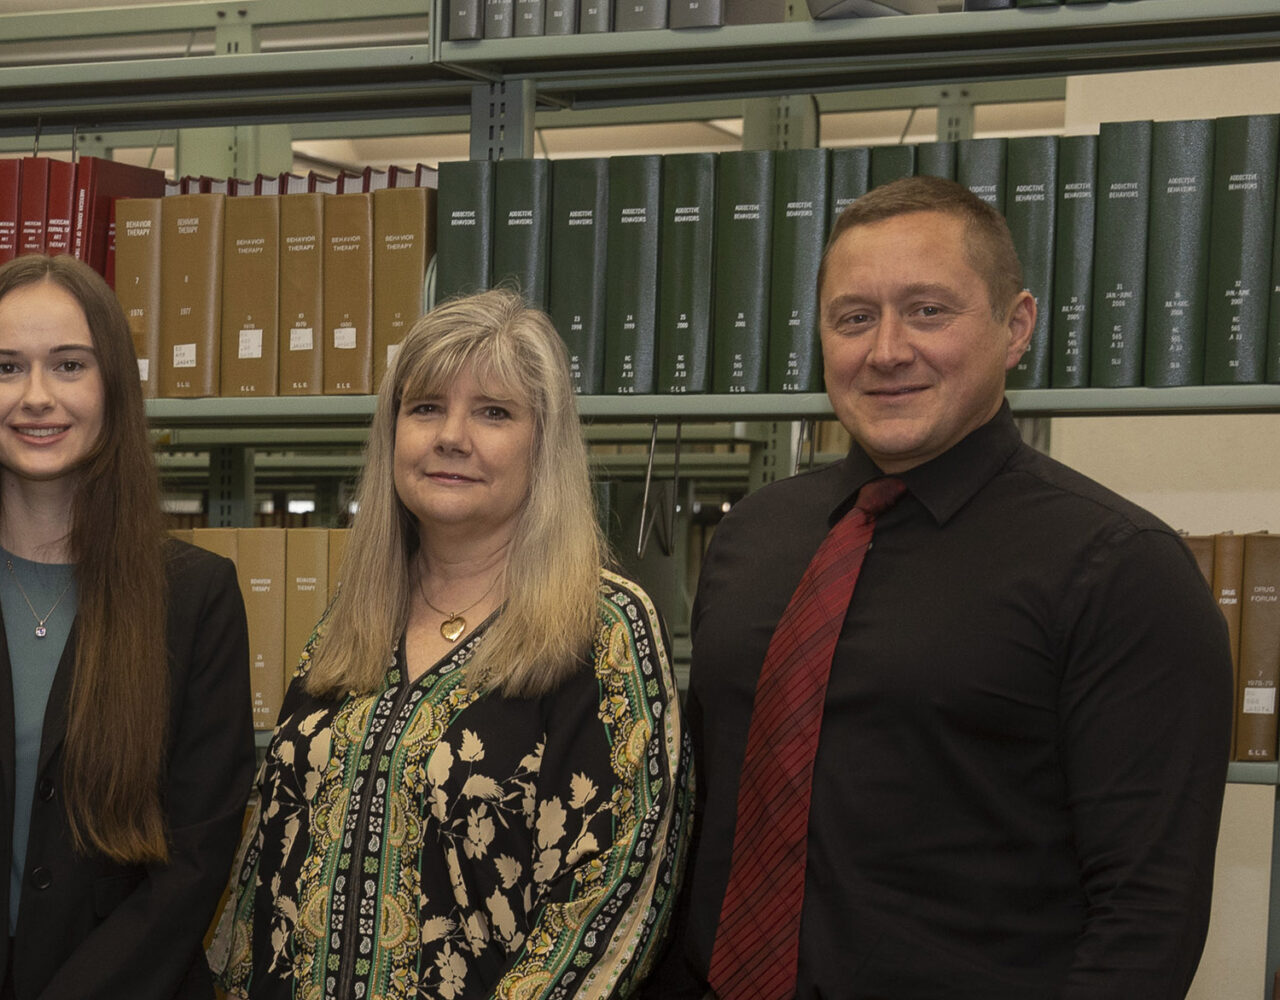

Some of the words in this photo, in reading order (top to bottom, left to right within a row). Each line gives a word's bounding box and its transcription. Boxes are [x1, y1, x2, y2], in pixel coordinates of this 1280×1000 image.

[1168, 177, 1195, 185] ADDICTIVE
[1229, 173, 1257, 182] ADDICTIVE
[1016, 184, 1044, 193] ADDICTIVE
[1064, 182, 1091, 190] ADDICTIVE
[1110, 182, 1138, 190] ADDICTIVE
[1167, 185, 1196, 193] BEHAVIORS
[1228, 182, 1258, 190] BEHAVIORS
[1015, 193, 1045, 202] BEHAVIORS
[1064, 191, 1092, 199] BEHAVIORS
[1109, 191, 1138, 199] BEHAVIORS
[126, 220, 151, 228] BEHAVIOR
[177, 218, 199, 226] BEHAVIOR
[127, 228, 150, 236] THERAPY
[178, 226, 199, 234] THERAPY
[331, 235, 361, 243] BEHAVIOR
[333, 244, 360, 252] THERAPY
